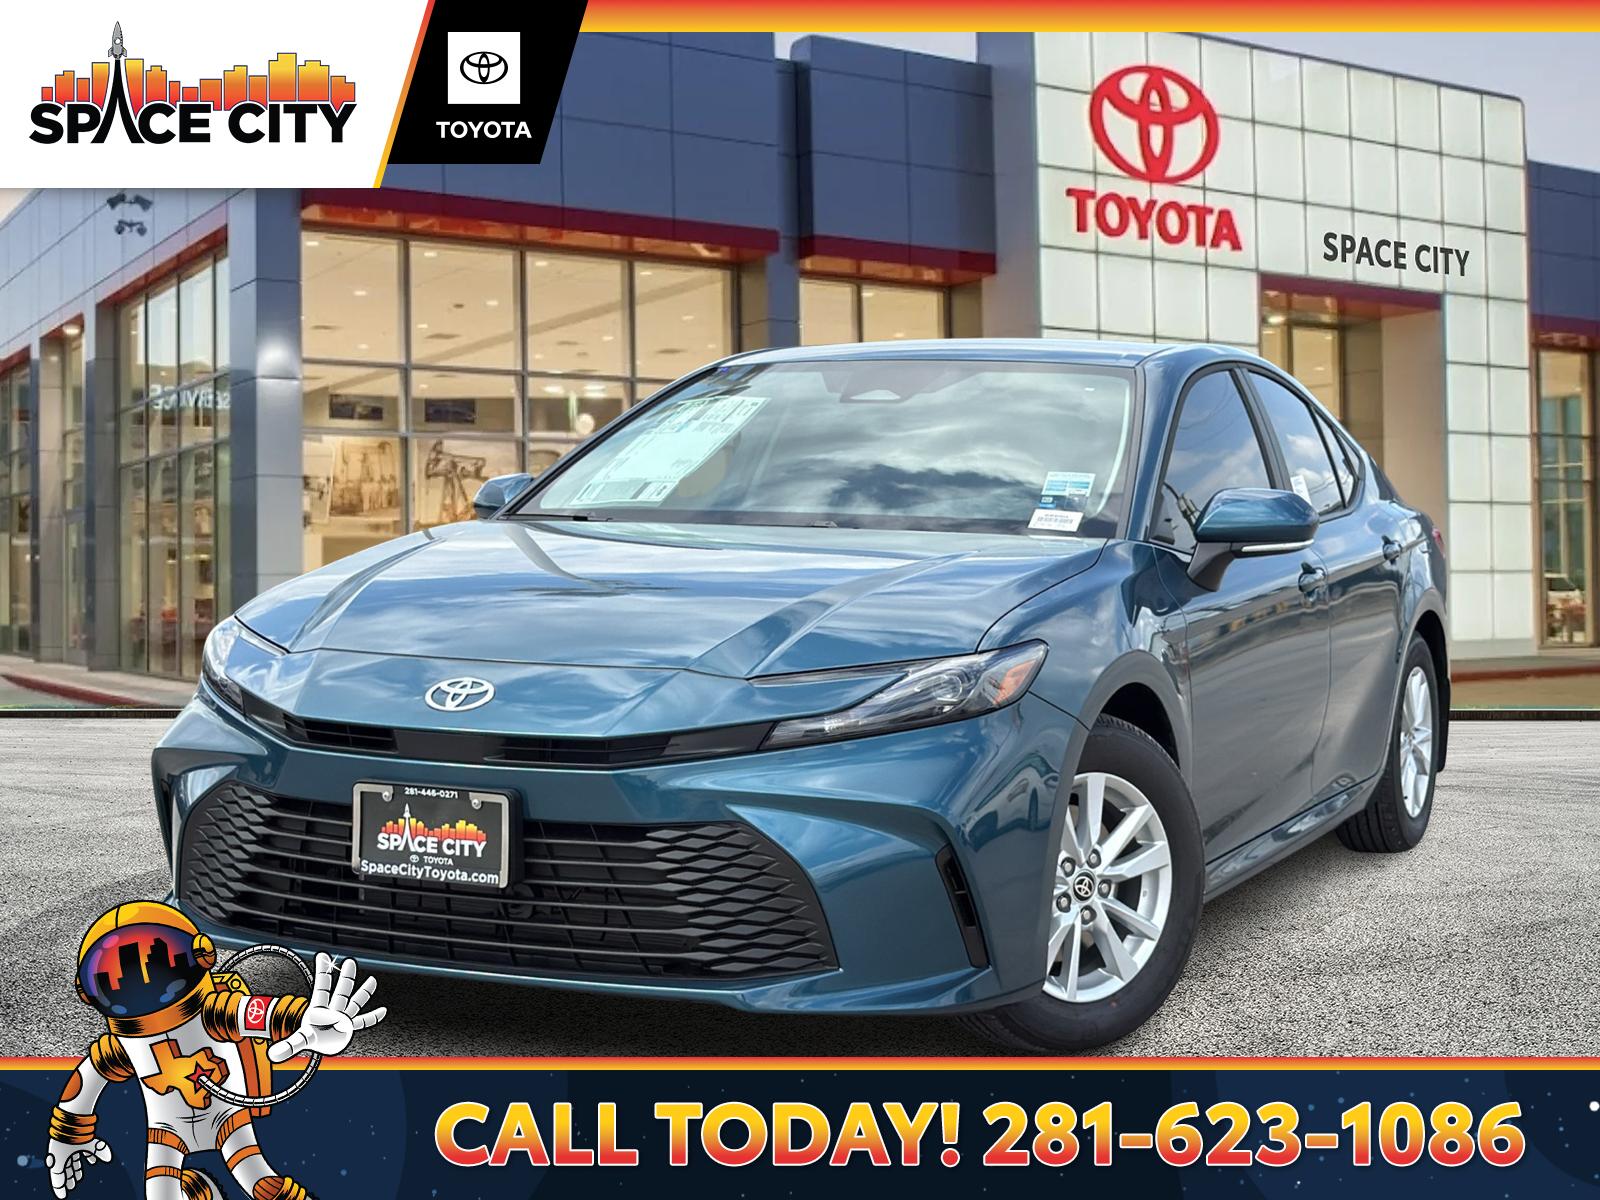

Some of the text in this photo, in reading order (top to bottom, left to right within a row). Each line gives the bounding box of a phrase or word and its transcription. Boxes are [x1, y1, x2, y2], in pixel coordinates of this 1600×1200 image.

[1065, 187, 1243, 251] TOYOTA
[1322, 231, 1470, 277] SPACE CITY
[377, 831, 488, 858] SPACE CITY
[360, 859, 500, 885] SpaceCityToyota.com
[423, 855, 454, 866] TOYOTA
